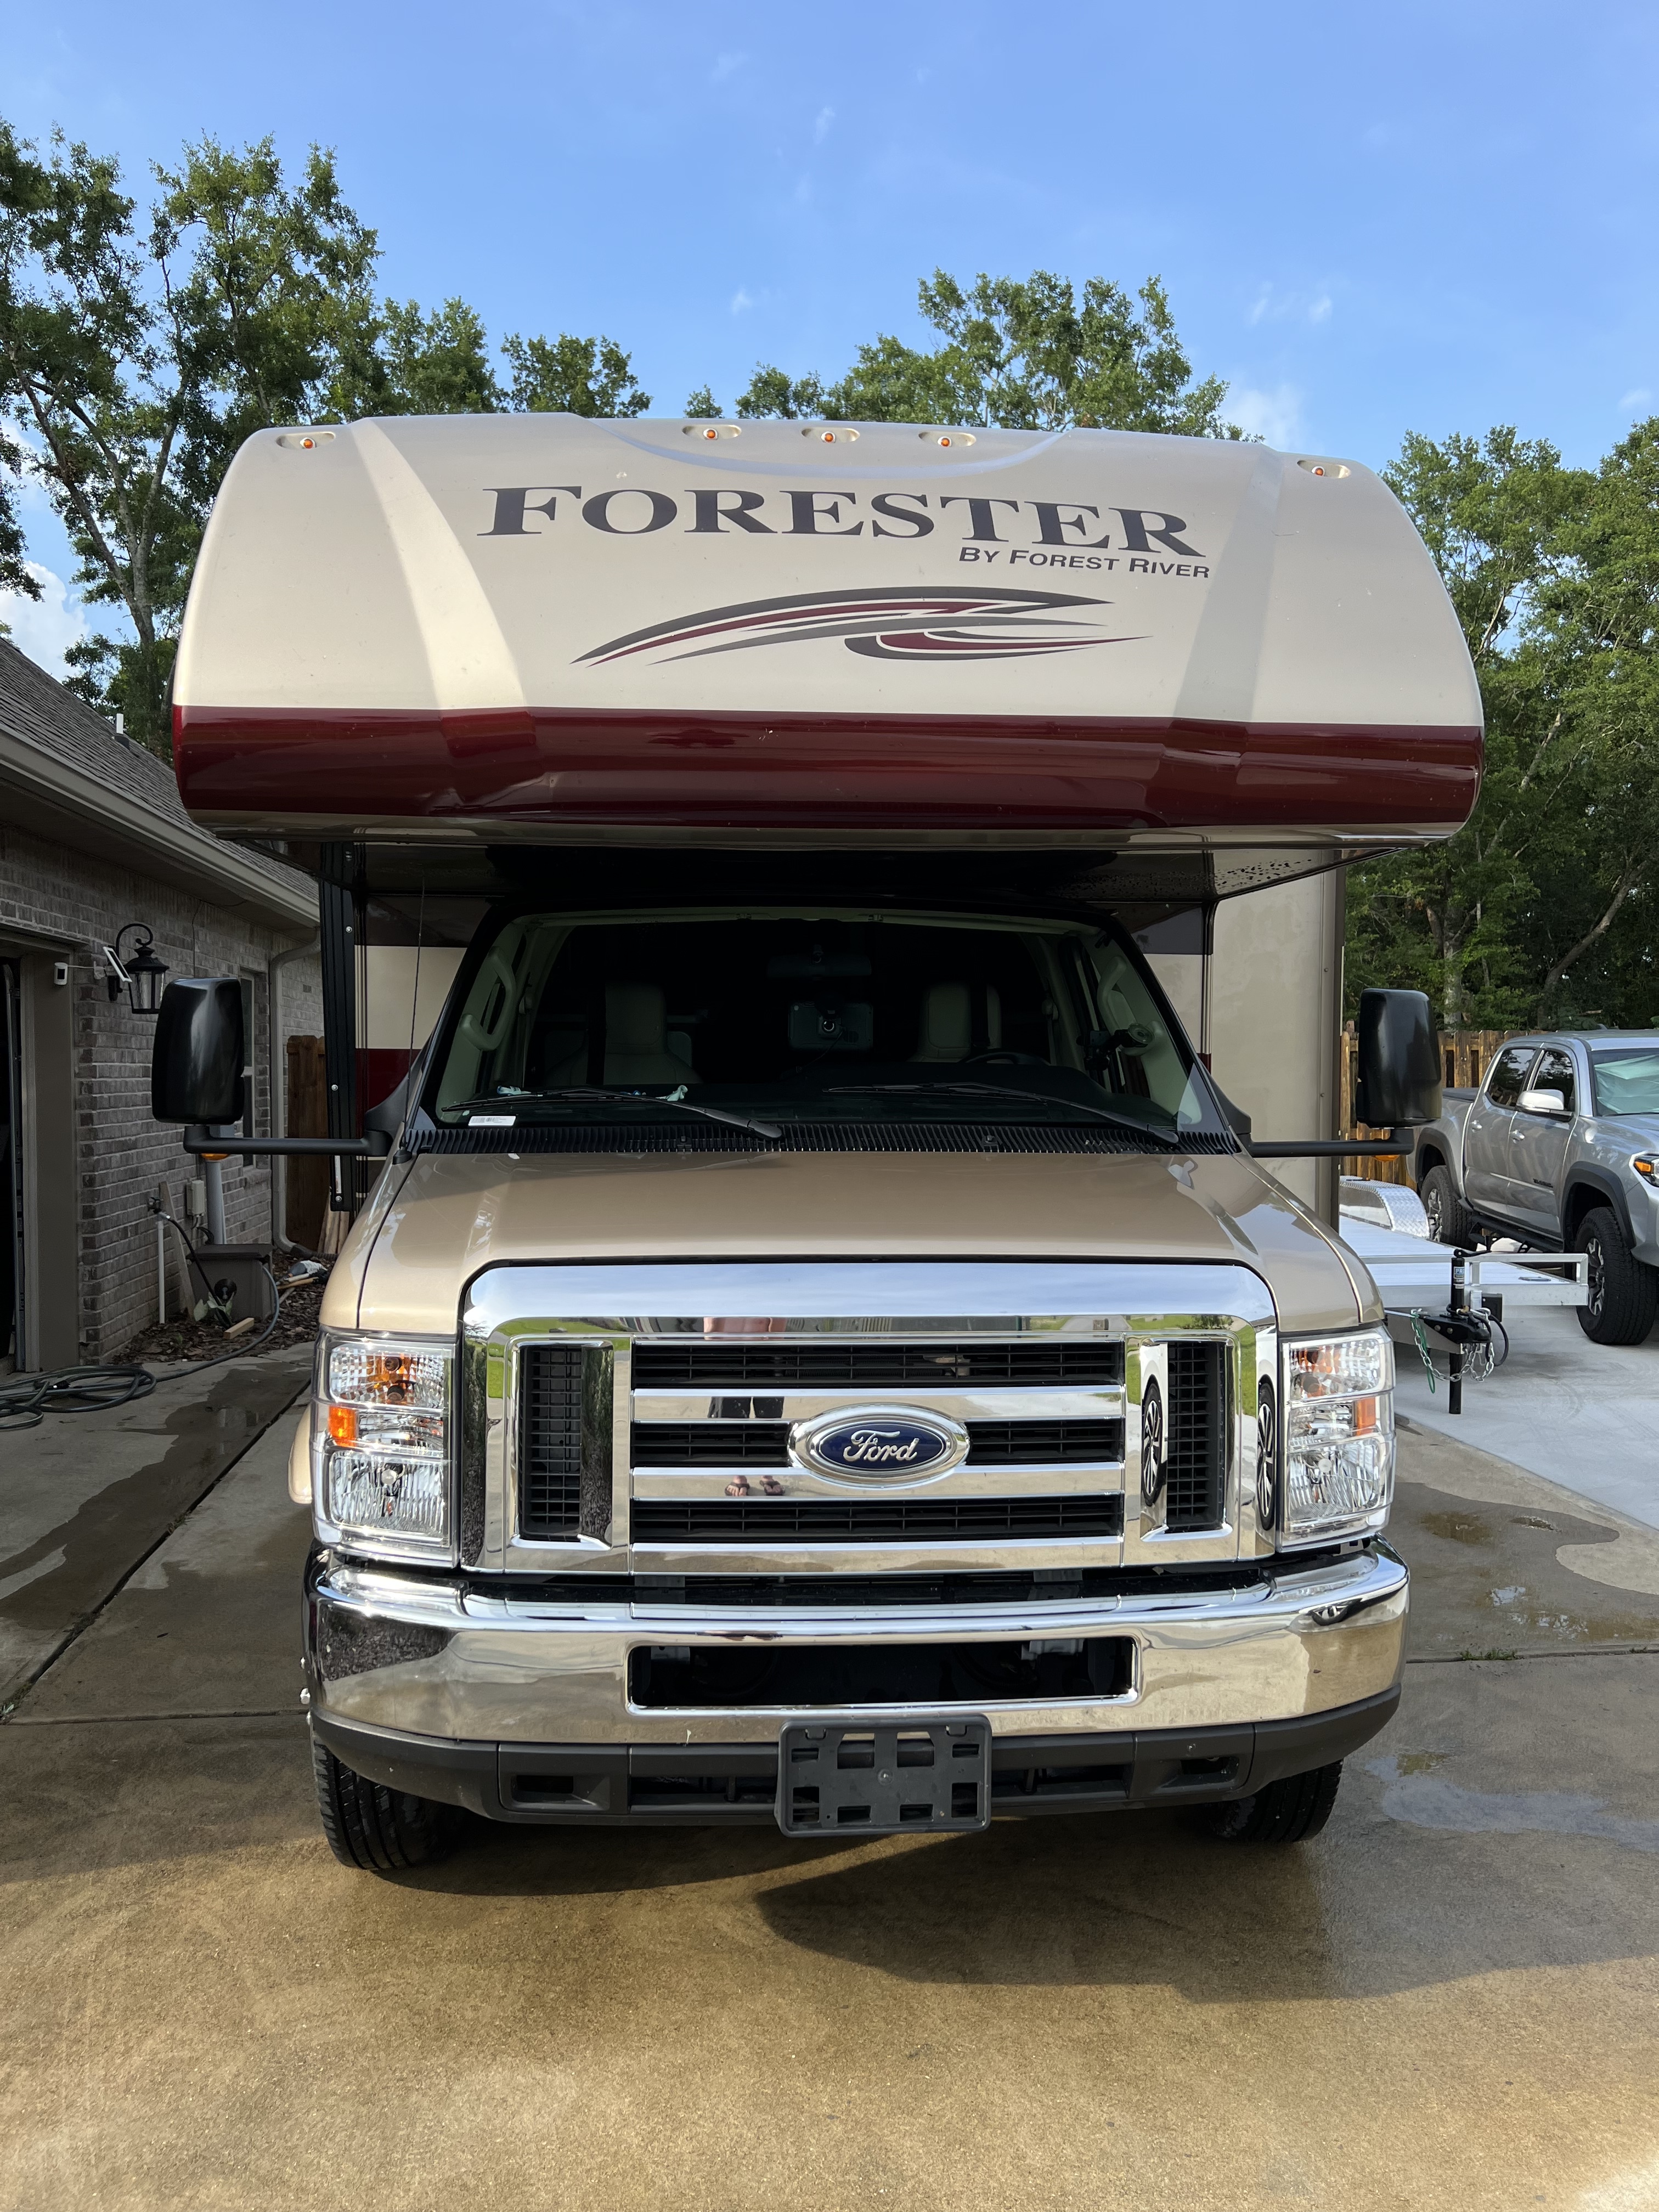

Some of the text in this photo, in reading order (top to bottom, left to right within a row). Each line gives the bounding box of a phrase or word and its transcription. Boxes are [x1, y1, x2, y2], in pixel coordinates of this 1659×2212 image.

[476, 486, 1206, 557] FORESTER
[1009, 549, 1120, 571] FOREST
[1128, 557, 1210, 579] RIVER
[843, 1430, 919, 1462] Ford
